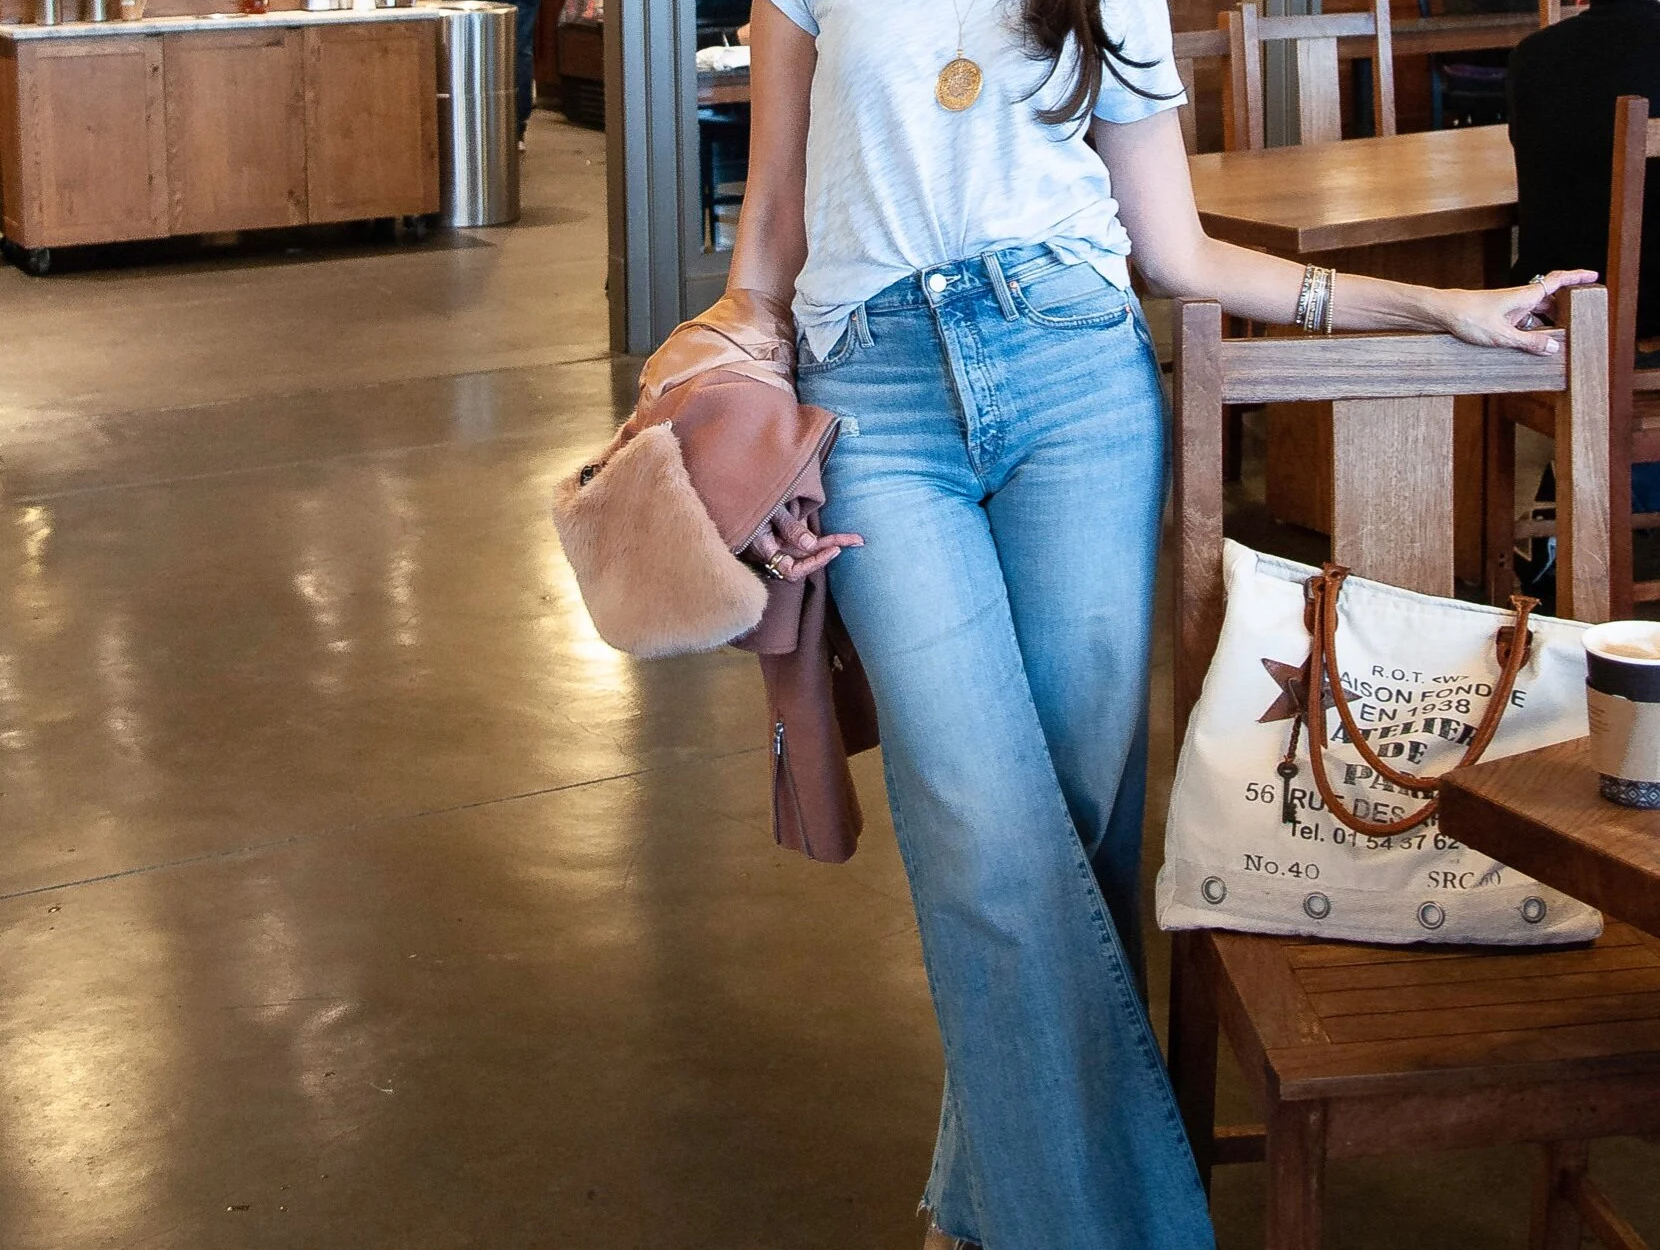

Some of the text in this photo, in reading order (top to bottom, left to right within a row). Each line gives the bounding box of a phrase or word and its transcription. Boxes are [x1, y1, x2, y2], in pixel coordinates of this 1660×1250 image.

[1372, 665, 1425, 685] R.O.T.
[1340, 671, 1527, 709] AISON FONDE
[1359, 699, 1471, 723] EN 1938
[1377, 740, 1428, 765] DE
[1245, 782, 1275, 804] 56
[1353, 797, 1405, 825] DES
[1366, 836, 1393, 851] 54
[1400, 834, 1427, 850] 37
[1427, 870, 1475, 890] SRC
